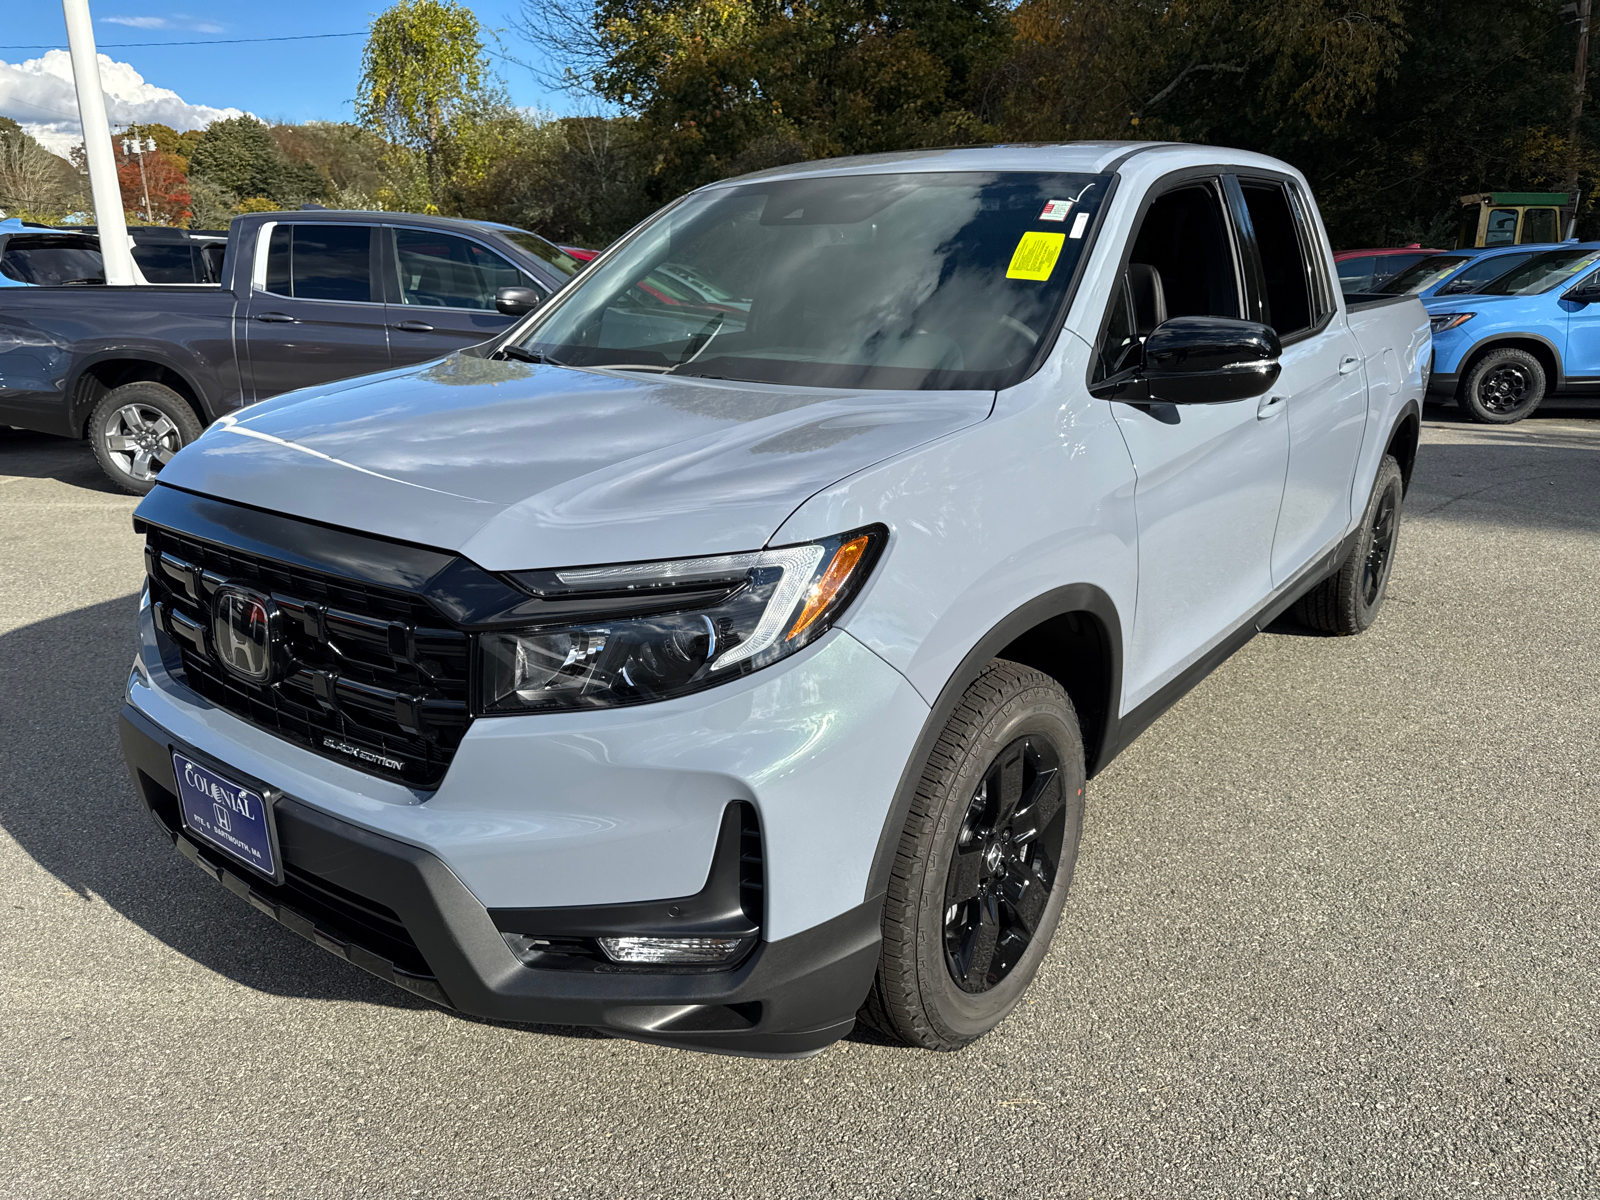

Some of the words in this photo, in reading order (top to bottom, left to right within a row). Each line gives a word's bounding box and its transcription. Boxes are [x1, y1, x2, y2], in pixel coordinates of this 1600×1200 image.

[323, 737, 360, 757] BLACK
[359, 750, 404, 770] EDITION
[184, 767, 255, 820] COLONIAL
[251, 847, 262, 859] MA
